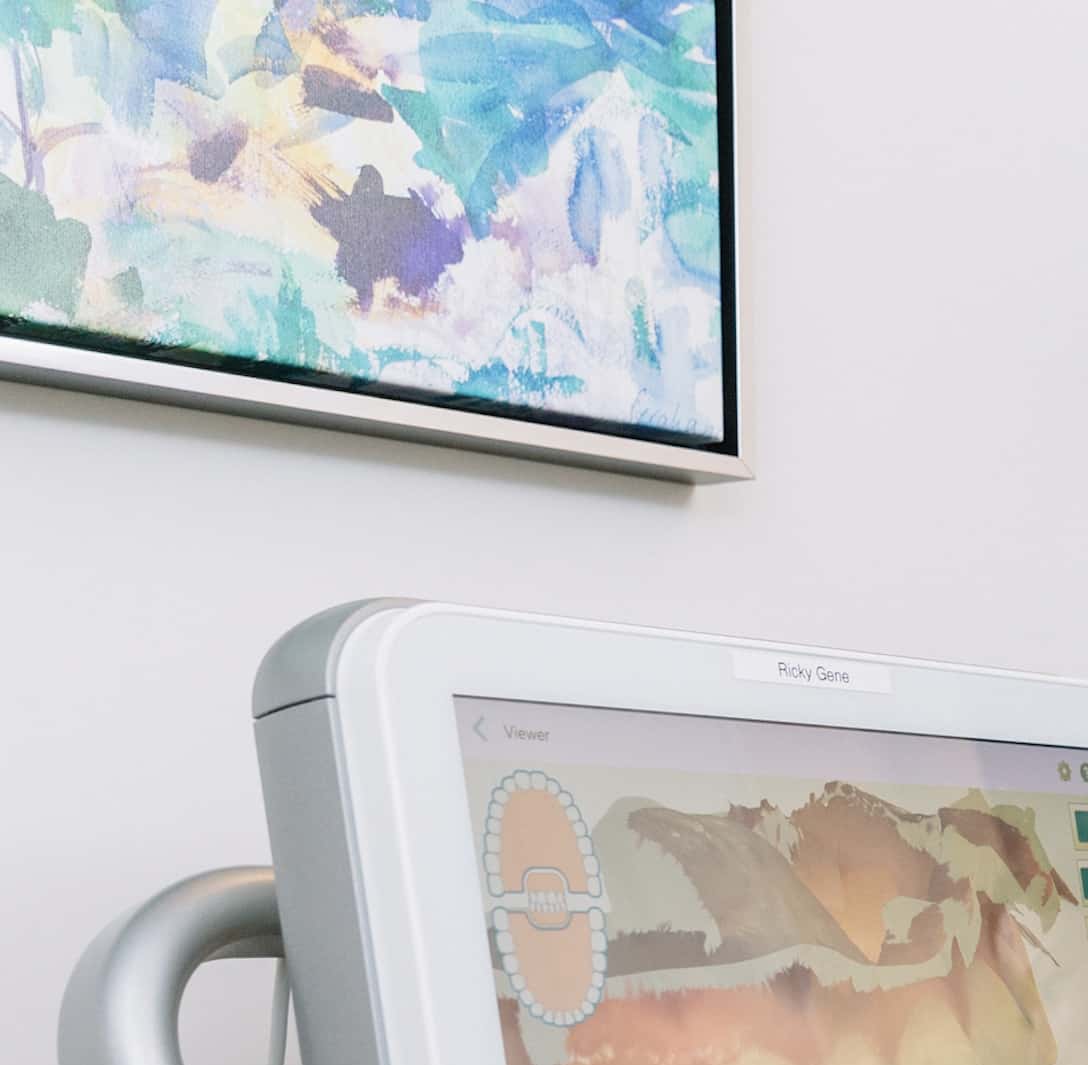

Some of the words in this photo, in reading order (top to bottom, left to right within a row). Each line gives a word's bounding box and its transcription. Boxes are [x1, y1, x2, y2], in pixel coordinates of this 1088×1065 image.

[777, 661, 812, 682] Ricky
[815, 665, 850, 684] Gene
[503, 724, 551, 742] Viewer
